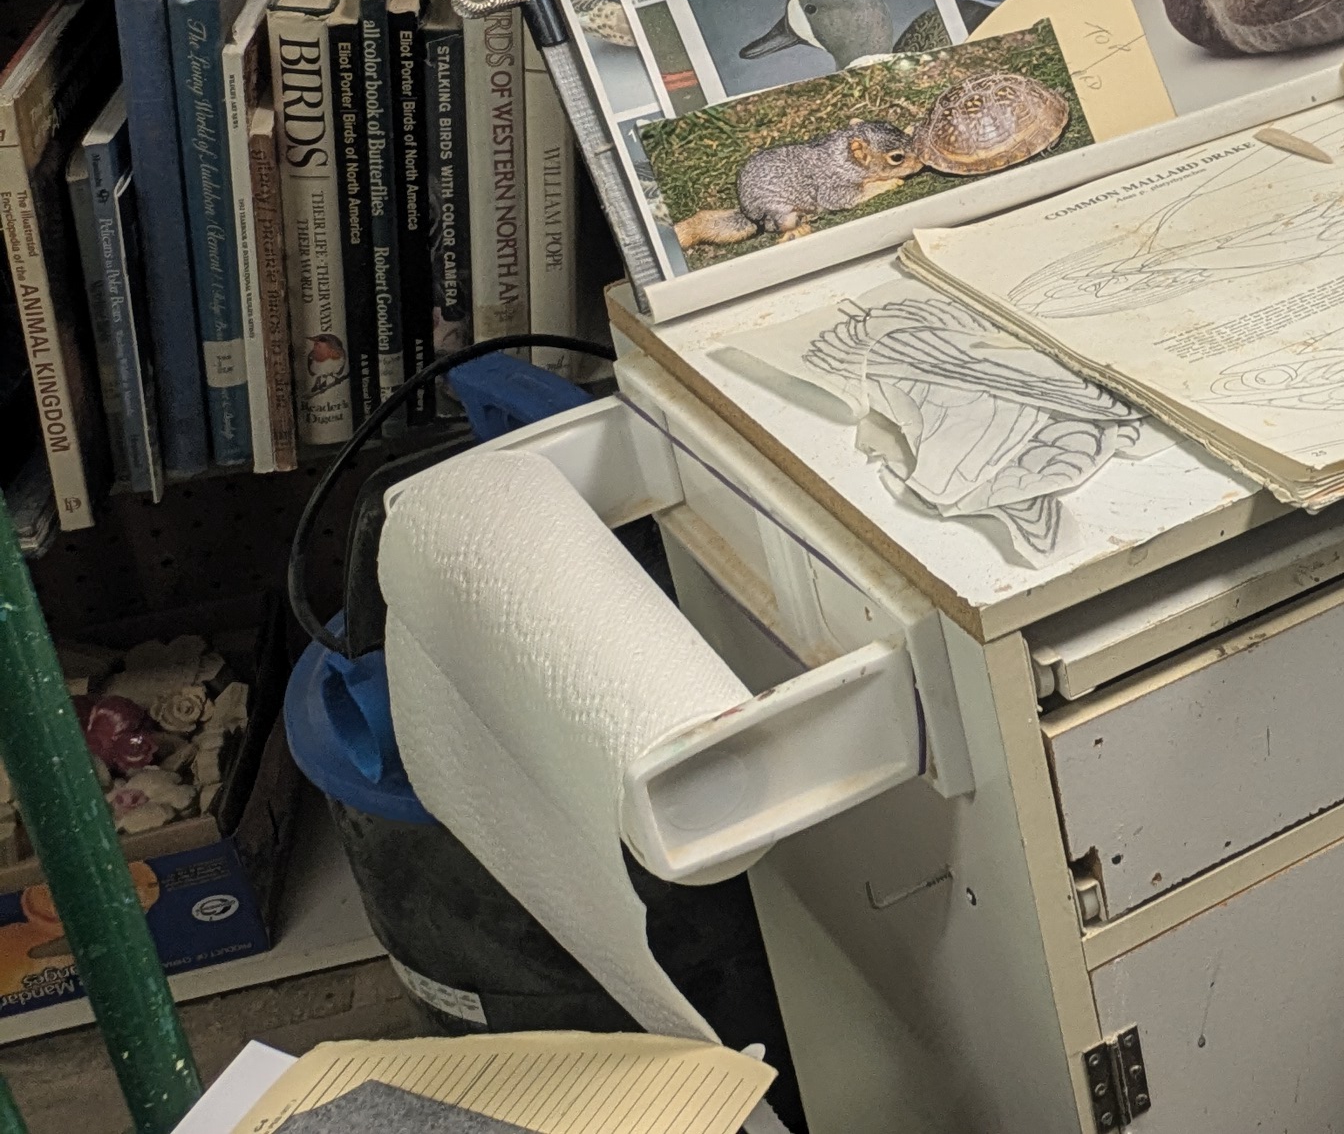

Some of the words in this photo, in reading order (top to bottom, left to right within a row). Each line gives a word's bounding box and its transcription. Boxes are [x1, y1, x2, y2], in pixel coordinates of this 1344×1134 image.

[362, 19, 376, 38] all
[400, 30, 413, 58] Eliot
[338, 42, 351, 70] Eliot
[363, 40, 379, 79] color
[339, 70, 354, 110] Porter
[401, 58, 415, 97] Porter
[436, 45, 452, 114] STALKING
[490, 70, 514, 101] OF
[278, 34, 330, 169] BIRDS
[365, 79, 384, 120] book
[402, 101, 417, 133] Birds
[342, 114, 356, 148] Birds
[367, 121, 380, 139] of
[438, 117, 453, 161] BIRDS
[404, 147, 419, 182] North
[492, 101, 515, 204] WESTERN
[345, 161, 360, 195] North
[367, 139, 388, 216] Butterflies
[440, 164, 454, 199] WITH
[543, 147, 563, 232] WILLIAM
[1044, 188, 1120, 221] COMMON
[1121, 161, 1200, 194] MALLARD
[1201, 140, 1253, 165] DRAKE
[16, 189, 27, 208] The
[405, 186, 419, 231] America
[1115, 194, 1138, 203] Anas
[1, 191, 22, 252] Encyclopedia
[15, 263, 27, 283] the
[20, 208, 39, 257] Illustrated
[99, 217, 113, 260] Pelicans
[349, 202, 362, 244] America
[441, 202, 456, 247] COLOR
[495, 203, 520, 275] NORTH
[373, 246, 391, 291] Robert
[545, 234, 563, 272] POPE
[443, 251, 458, 307] CAMERA
[19, 284, 50, 359] ANIMAL
[374, 291, 394, 352] Goodden
[34, 362, 70, 454] KINGDOM
[1311, 449, 1328, 459] 25
[22, 965, 78, 988] anges
